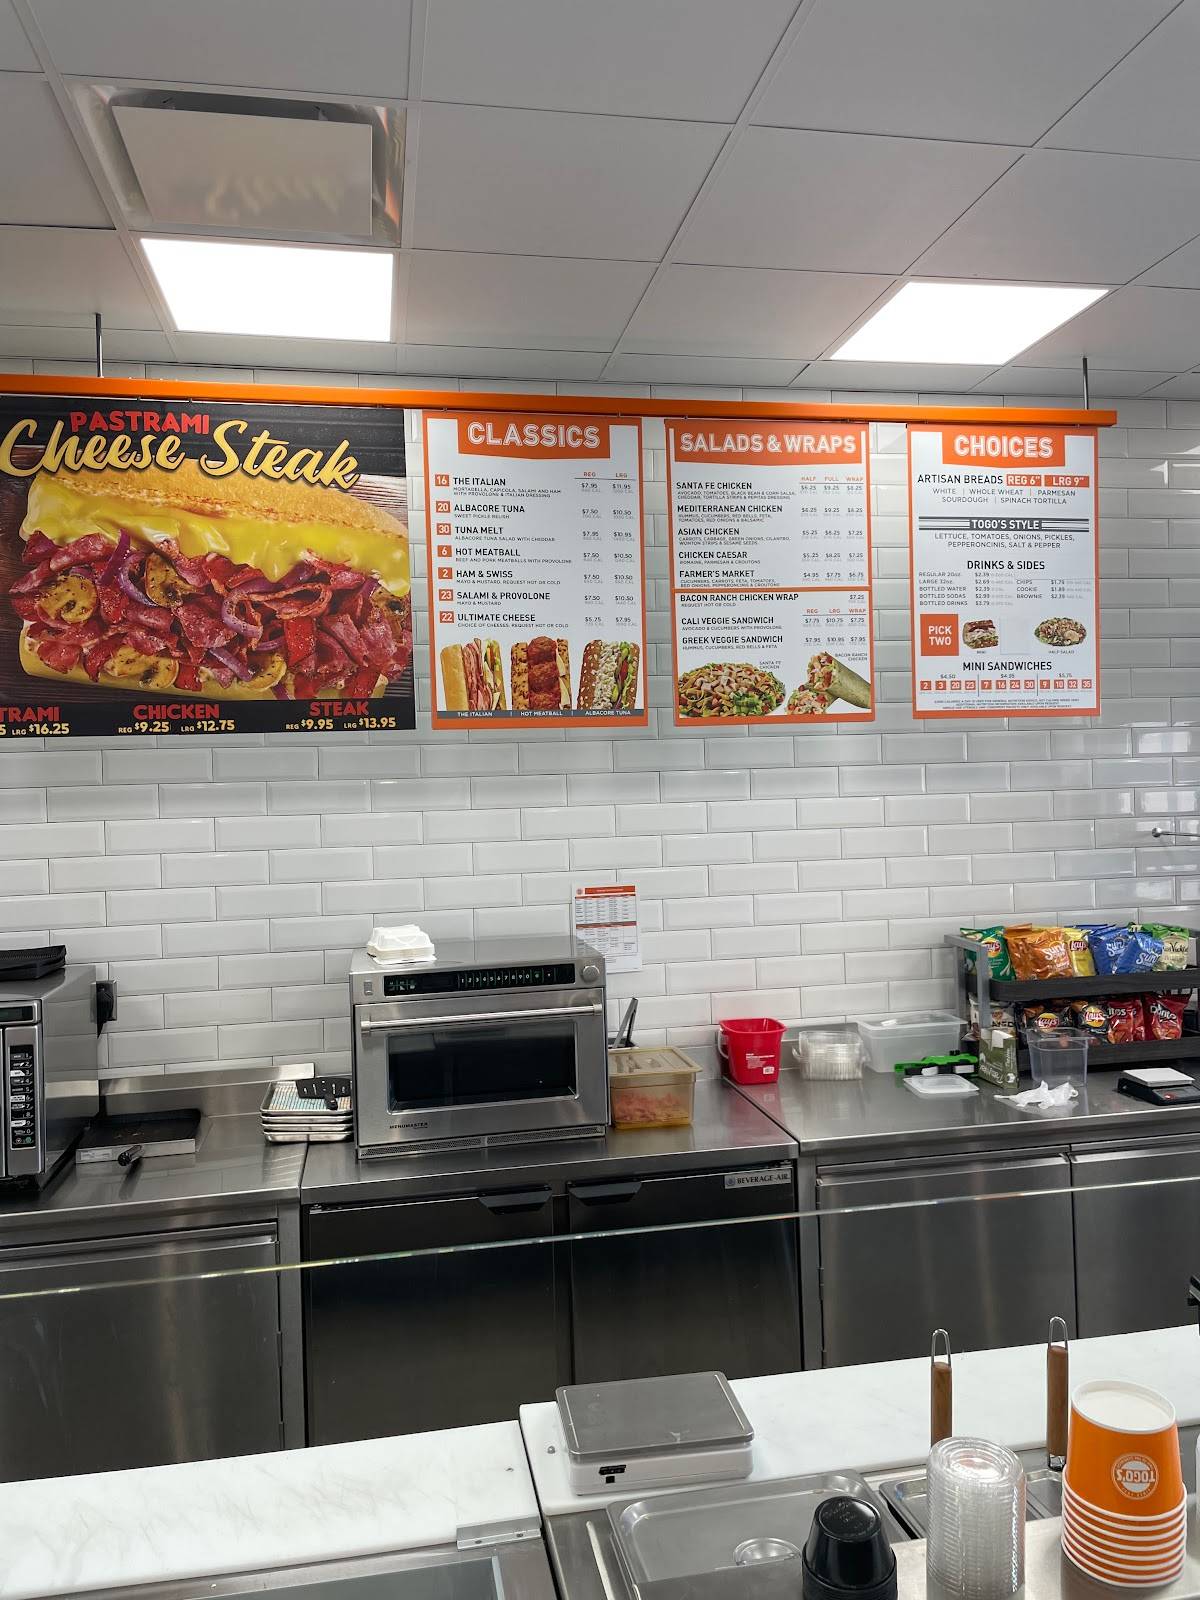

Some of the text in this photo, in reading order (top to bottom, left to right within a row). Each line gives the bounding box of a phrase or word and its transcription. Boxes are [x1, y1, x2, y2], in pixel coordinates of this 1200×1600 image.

[70, 411, 209, 434] PASTRAMI
[468, 422, 600, 448] CLASSICS
[680, 433, 856, 453] SALADS & WRAPS
[954, 435, 1053, 458] CHOICES
[0, 418, 360, 490] Cheese Steak
[437, 476, 505, 486] 16 THE ITALIAN
[917, 474, 1084, 485] ARTISAN BREADS REG 6" LRG 9"
[437, 503, 448, 511] 20
[454, 504, 499, 512] ALBACORE
[438, 525, 449, 533] 30
[972, 520, 1039, 529] TOGO'S STYLE
[441, 547, 447, 555] 6
[967, 561, 1045, 569] DRINKS & SIDES
[442, 569, 448, 577] 2
[441, 591, 452, 599] 23
[442, 613, 452, 621] 22
[928, 626, 952, 634] PICK
[929, 637, 952, 645] TWO
[963, 662, 1052, 670] MINI SANDWICHES
[0, 706, 61, 722] TRAMI
[133, 704, 219, 720] CHICKEN
[309, 701, 368, 717] STEAK
[134, 721, 169, 732] $9.25
[197, 720, 235, 732] $12.75
[301, 719, 333, 730] $9.95
[359, 717, 396, 728] $13.95
[29, 723, 69, 735] $16.25
[737, 1174, 788, 1184] BEVERAGE-AIR
[1116, 1469, 1155, 1483] TOGO'S
